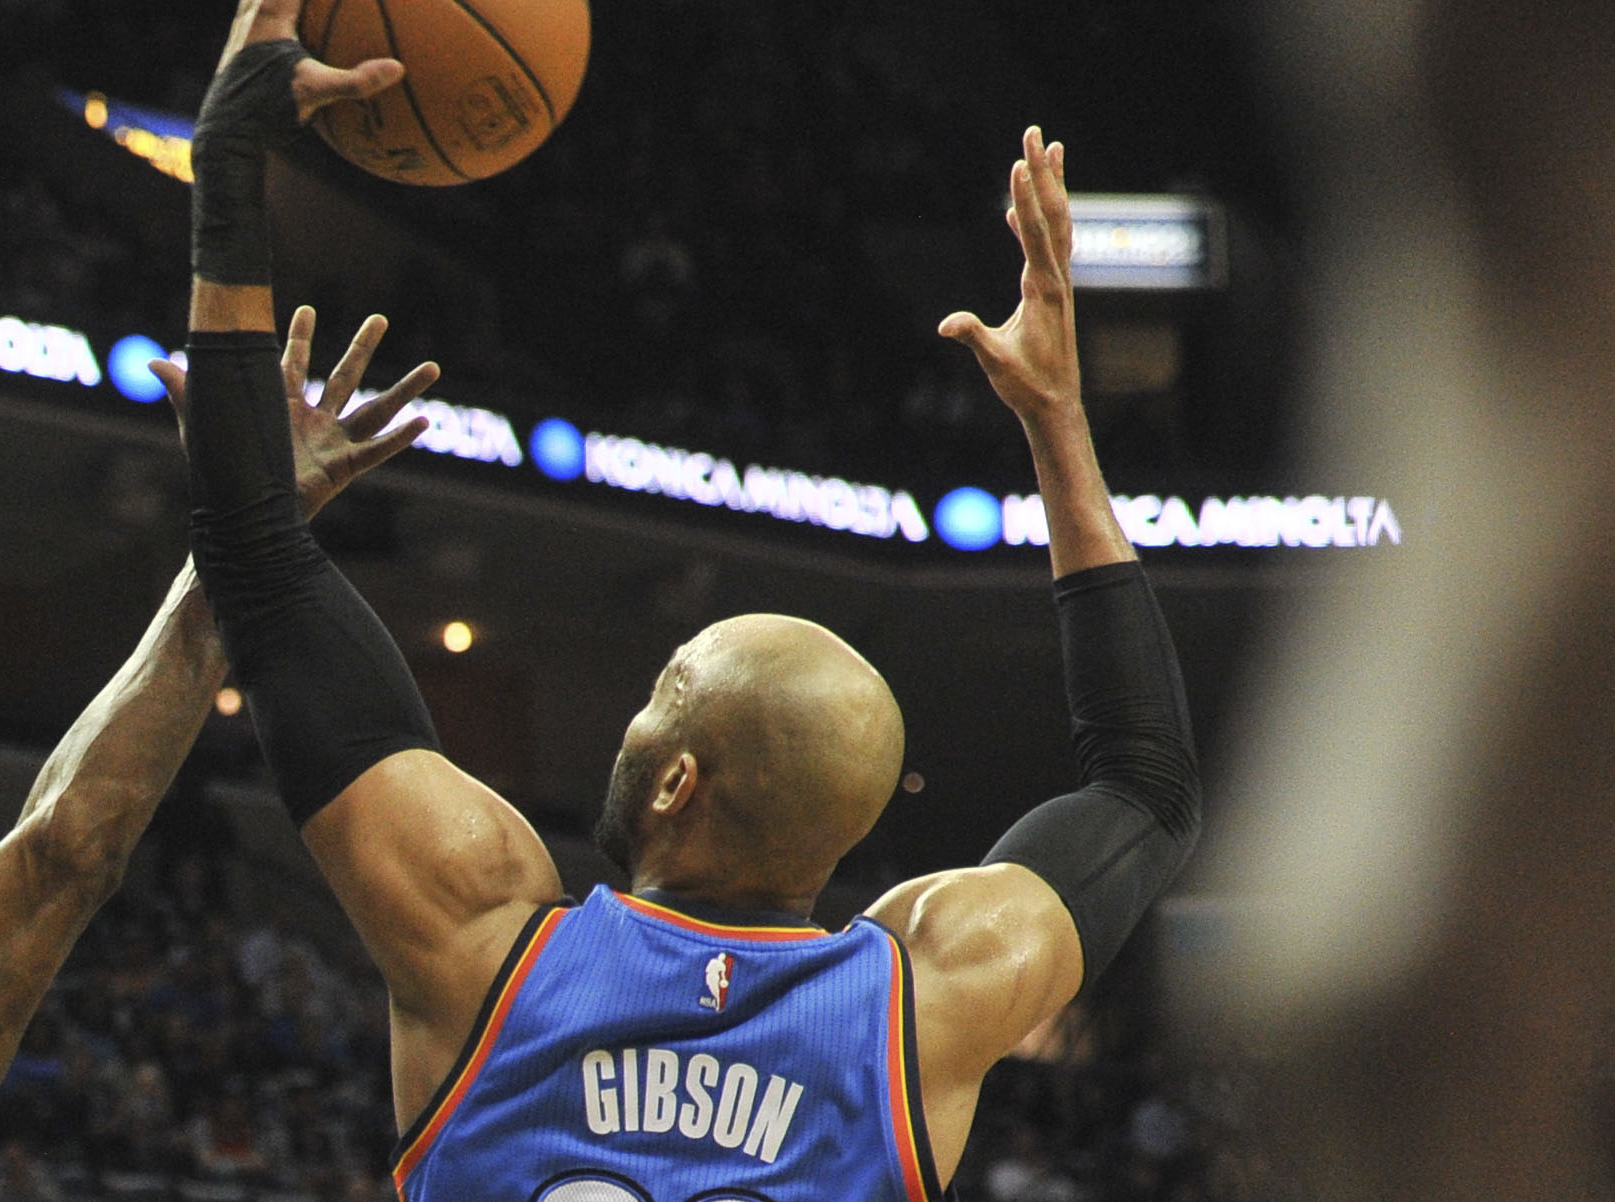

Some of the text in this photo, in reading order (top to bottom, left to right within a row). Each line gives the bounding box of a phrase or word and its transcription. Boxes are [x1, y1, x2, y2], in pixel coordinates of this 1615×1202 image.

[586, 431, 929, 543] KONICA MINOLTA
[1002, 494, 1402, 547] KICA MINOLTA
[582, 1048, 804, 1164] GIBSON
